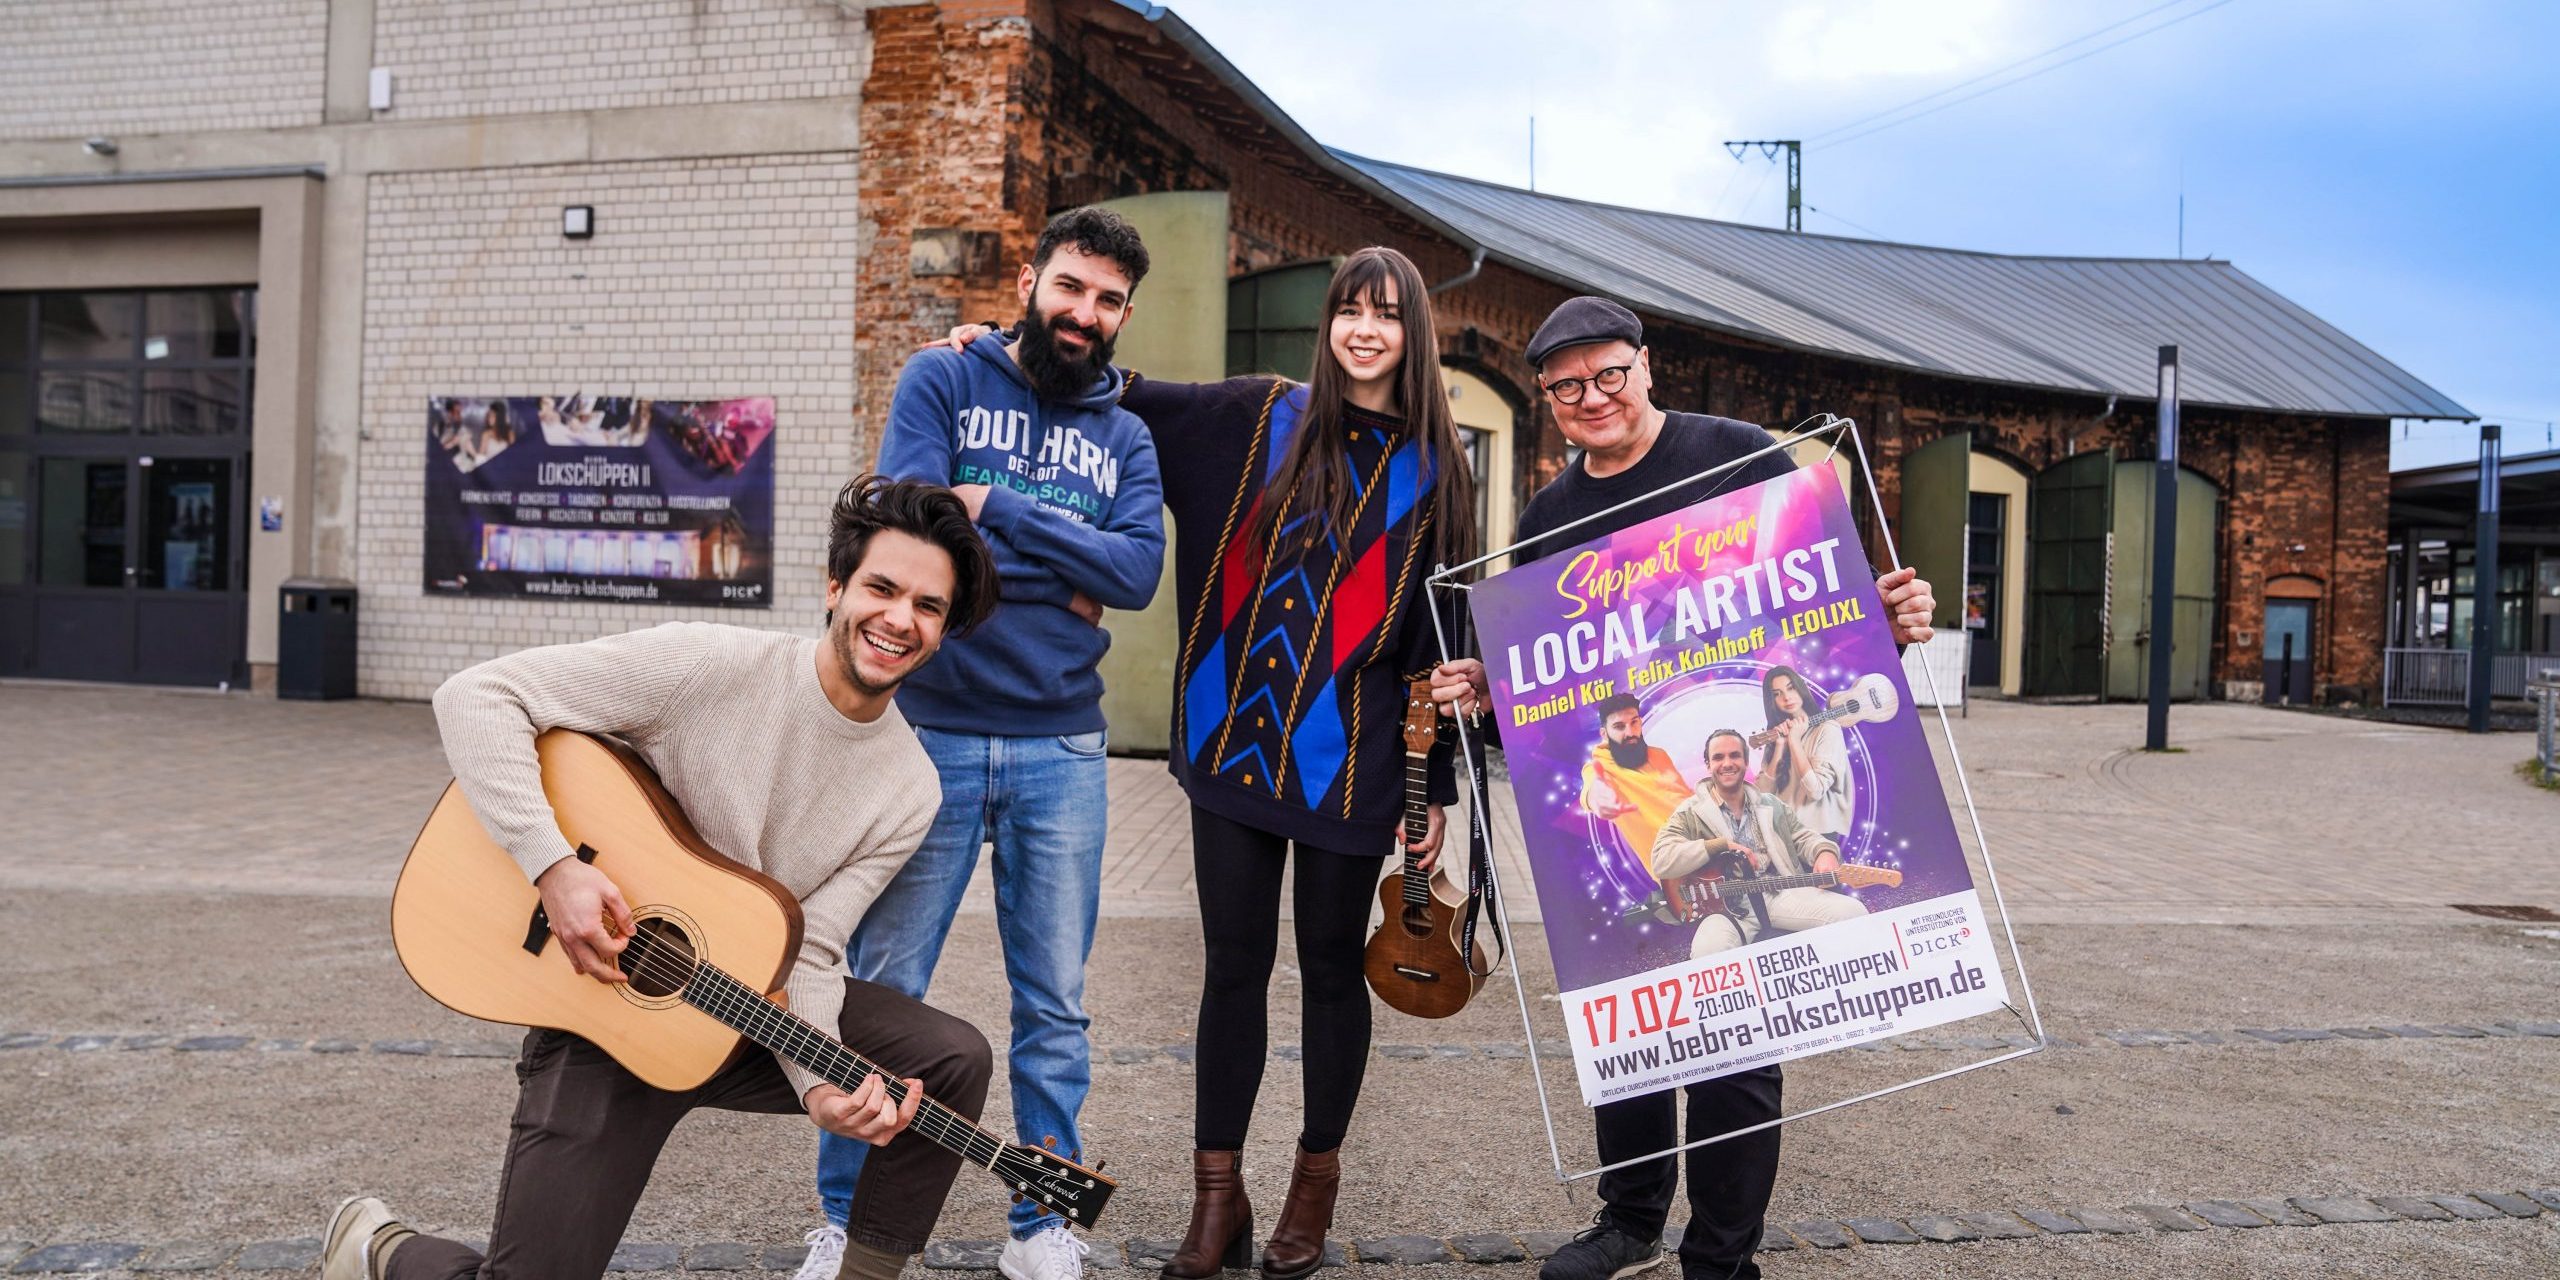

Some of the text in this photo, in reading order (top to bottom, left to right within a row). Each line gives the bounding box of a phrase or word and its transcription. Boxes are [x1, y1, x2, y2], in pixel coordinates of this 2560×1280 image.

[957, 405, 1118, 498] SOUTHERN
[537, 463, 651, 488] LOKSCHUPPEN II
[954, 464, 1011, 488] JEAN
[1015, 479, 1099, 518] PASCALE
[567, 493, 607, 507] TAGUNGEN
[1556, 513, 1757, 620] Support your
[525, 578, 659, 599] www.bebra-lokschuppen.de
[722, 584, 755, 599] DICK
[1507, 537, 1842, 695] LOCAL ARTIST
[1513, 597, 1866, 727] Daniel Kör Felix Kohlhoff LEOLIXL
[1905, 915, 1967, 937] UNTERSTÜTZUNG VON
[1911, 908, 1964, 926] MIT FREUNDLICHER
[1756, 943, 1820, 978] BEBRA
[1910, 933, 1962, 957] DICK
[1763, 950, 1900, 1003] LOKSCHUPPEN
[1583, 961, 1745, 1048] 17.02 2023
[1594, 959, 1987, 1081] www.bebra-lokschuppen.de
[1695, 988, 1757, 1021] 20:00h
[1602, 1085, 1628, 1098] ÖRTLICHE
[1716, 1061, 1733, 1072] GMBH
[1735, 1048, 1785, 1066] RATHAUSSTRASSE
[1811, 1036, 1830, 1048] BEBRA
[1036, 1174, 1081, 1201] Lakewood
